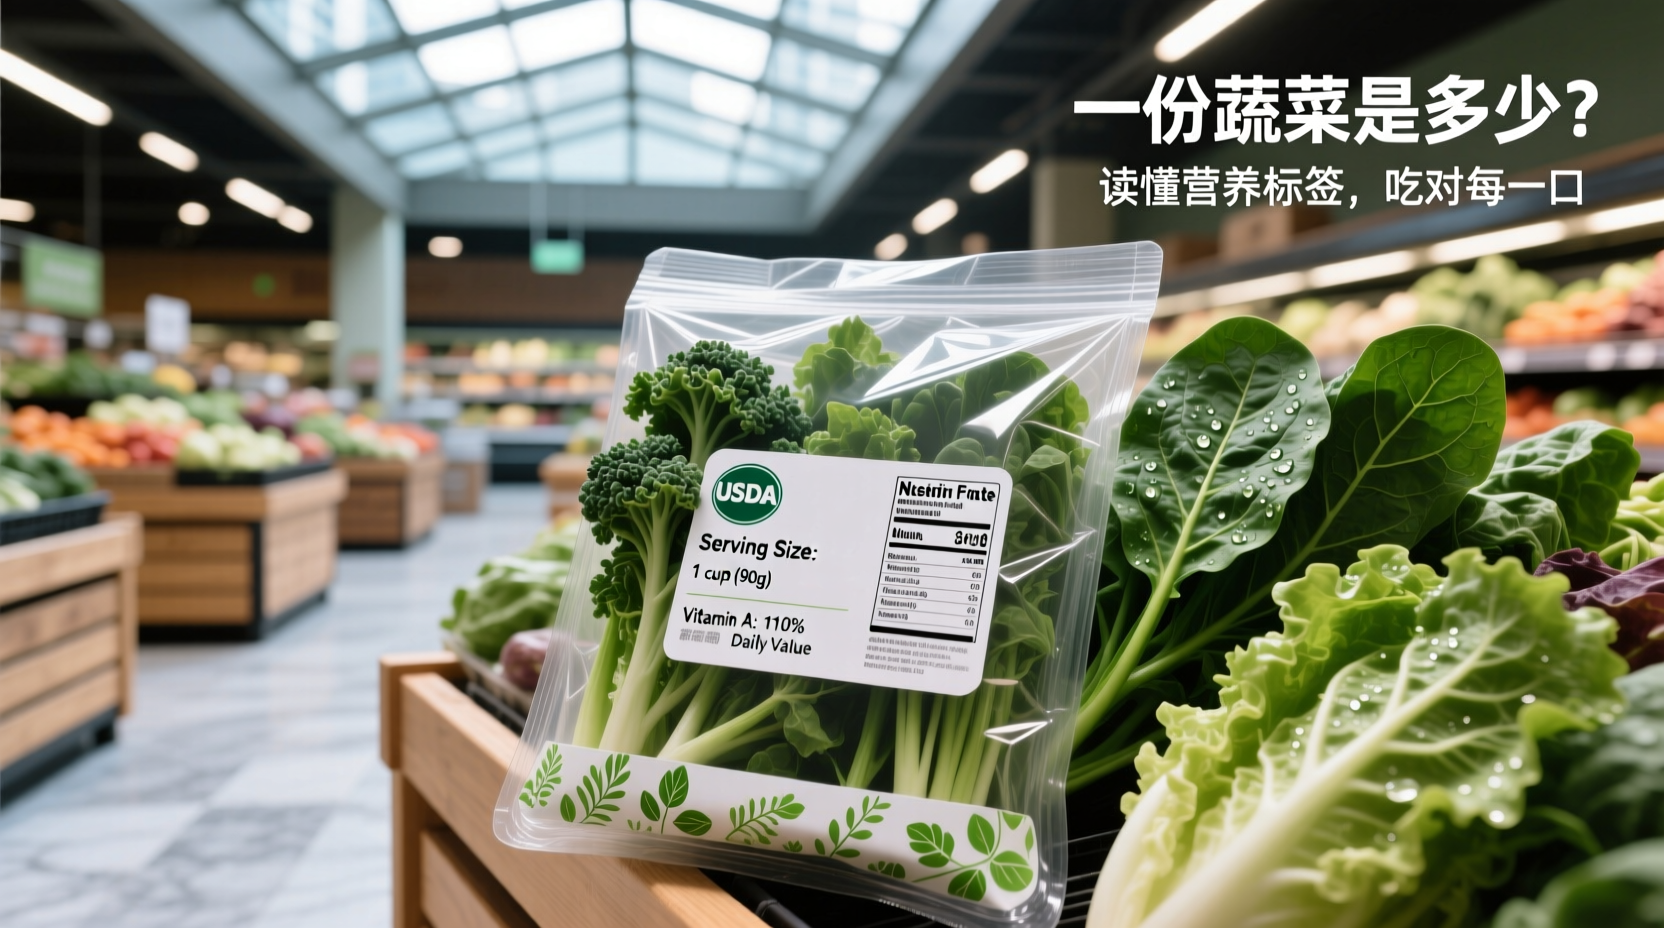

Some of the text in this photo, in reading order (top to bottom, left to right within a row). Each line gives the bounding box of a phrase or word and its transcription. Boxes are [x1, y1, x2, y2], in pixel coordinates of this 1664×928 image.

[715, 481, 778, 506] USDA
[698, 532, 818, 561] Serving Size:
[692, 563, 772, 590] 1 cup (90g)
[683, 606, 806, 634] Vitamin A: 110%
[731, 633, 767, 655] Daily
[771, 637, 812, 656] Value
